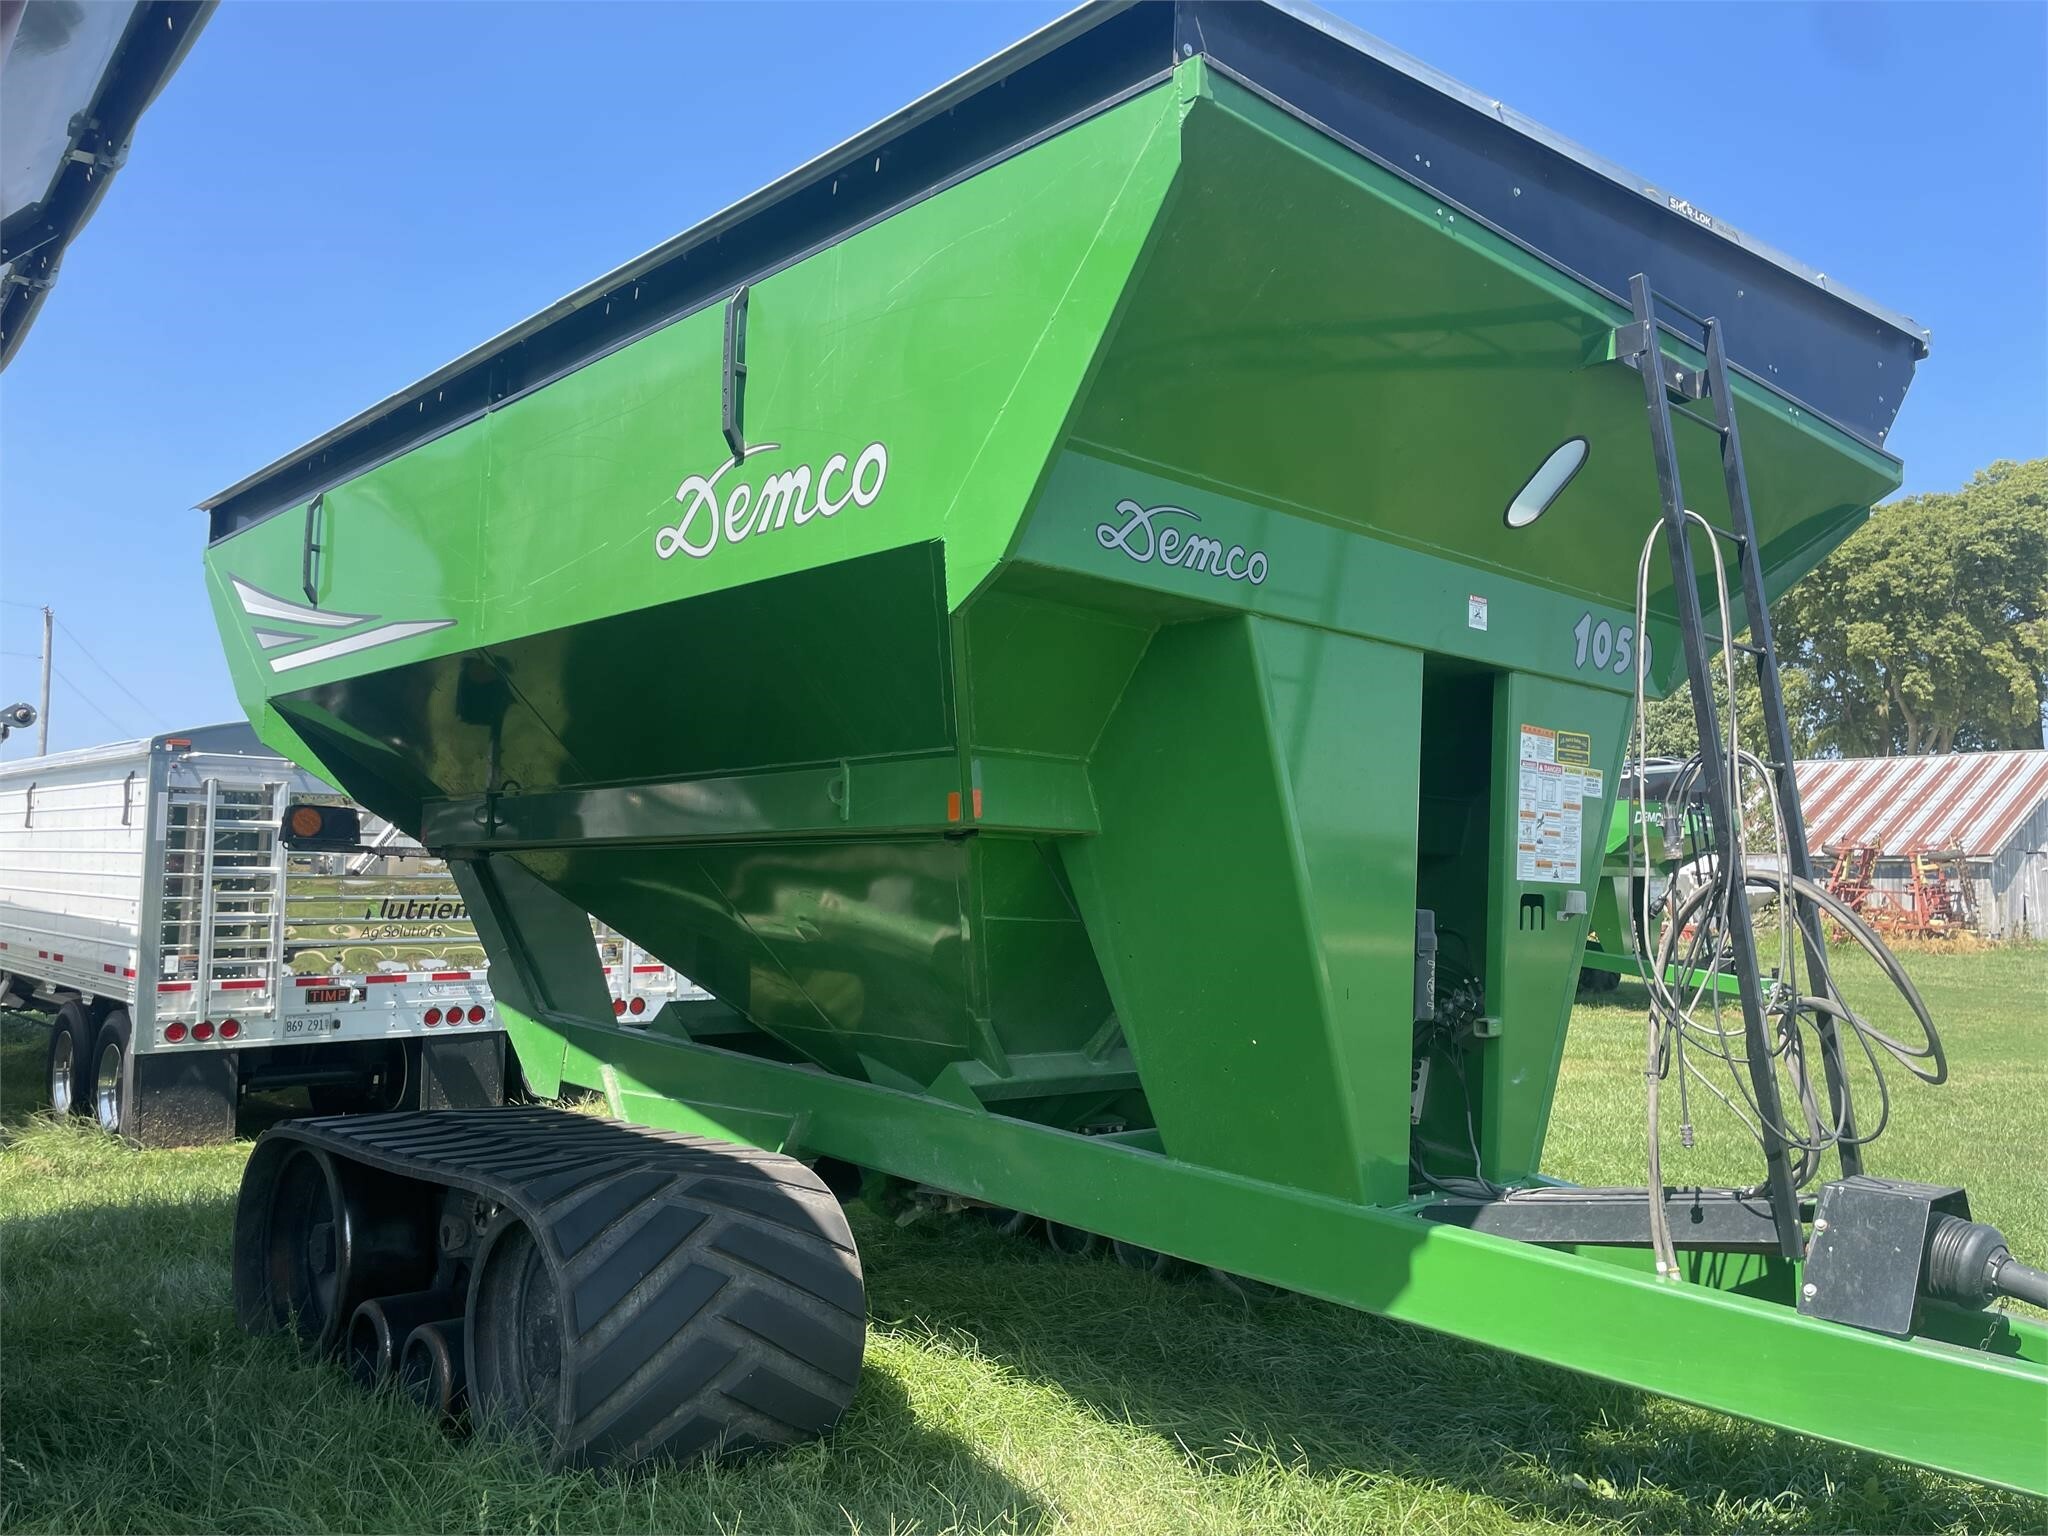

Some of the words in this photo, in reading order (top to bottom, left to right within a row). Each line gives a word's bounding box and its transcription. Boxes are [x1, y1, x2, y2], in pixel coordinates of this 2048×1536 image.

[655, 441, 888, 560] Demco
[1096, 499, 1268, 585] Demco
[360, 926, 379, 941] Ag
[383, 924, 442, 937] Solutions
[310, 988, 365, 1002] TIMPE
[286, 1020, 303, 1032] 869
[307, 1019, 323, 1031] 291
